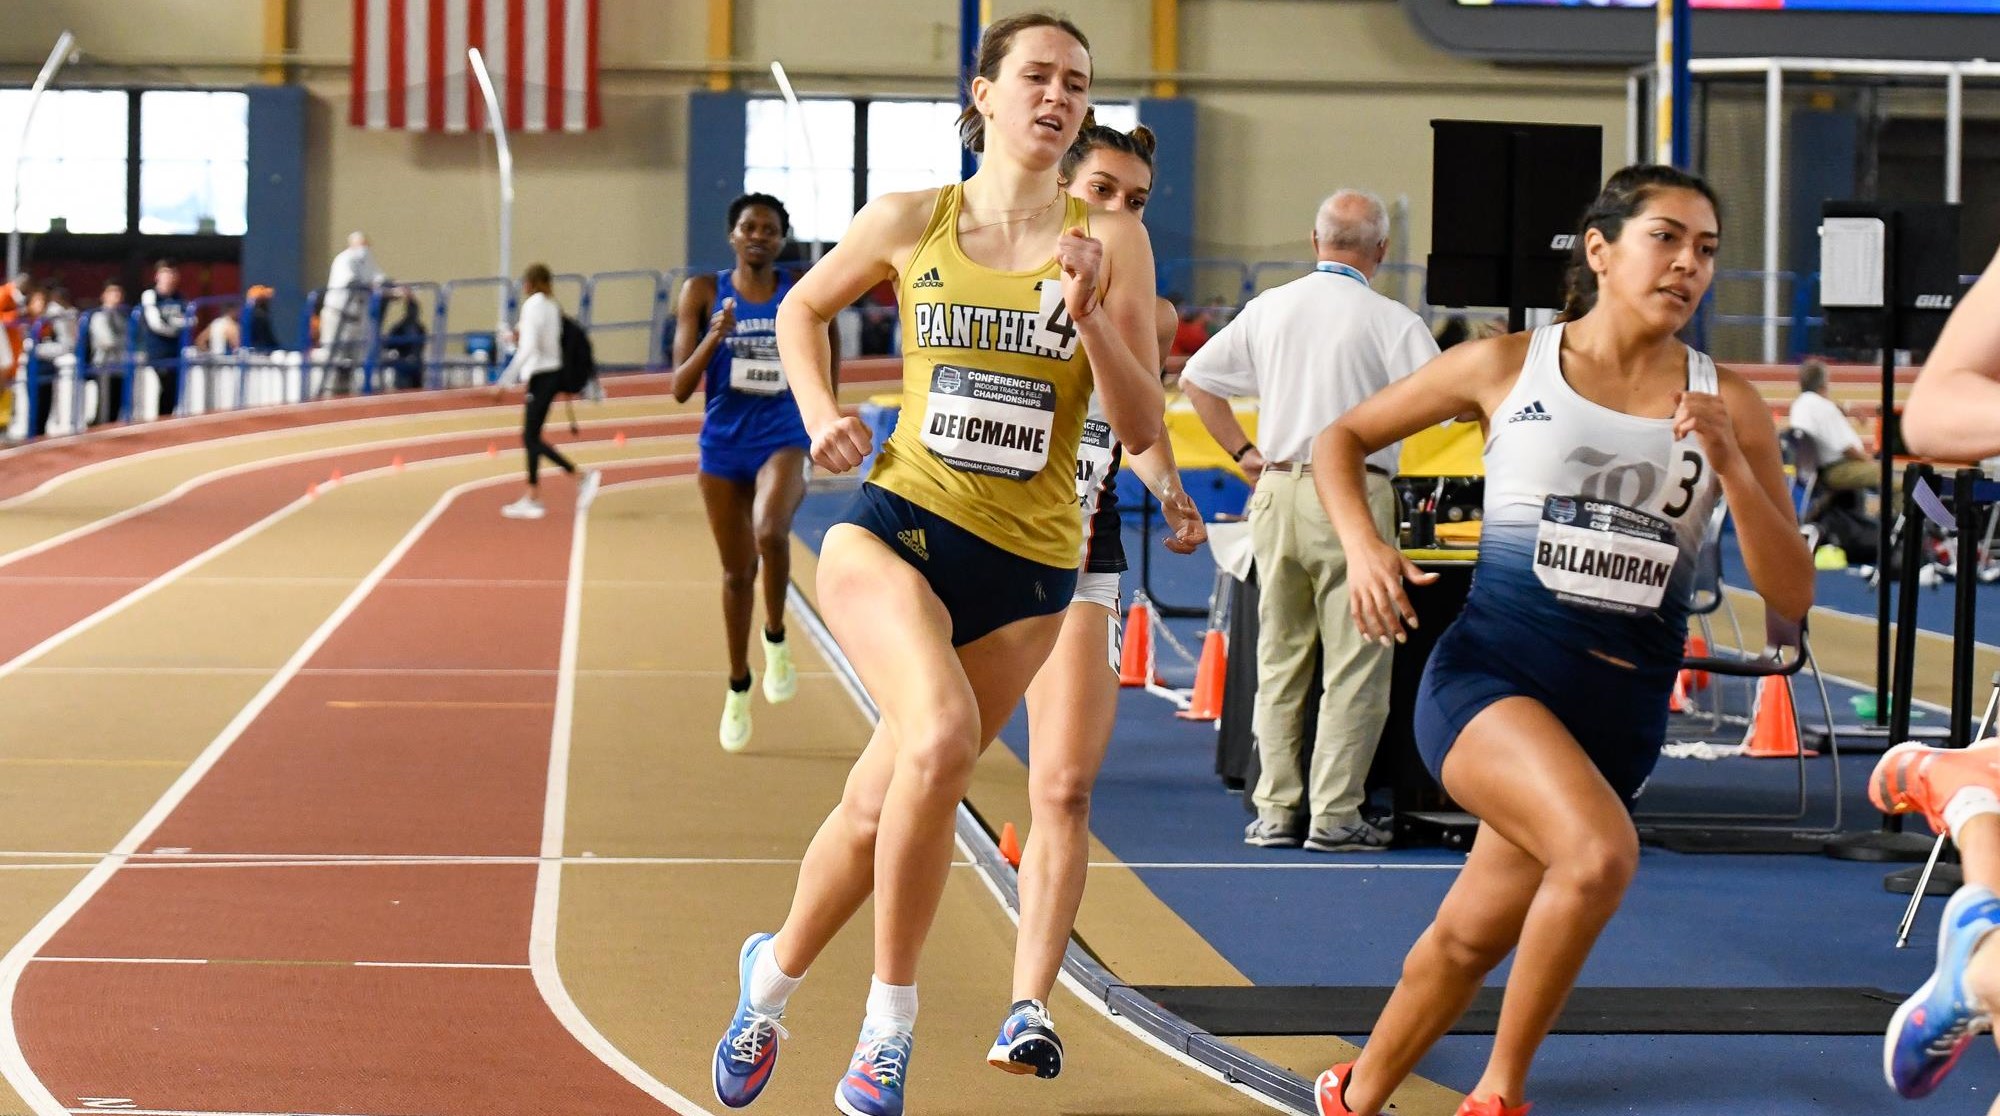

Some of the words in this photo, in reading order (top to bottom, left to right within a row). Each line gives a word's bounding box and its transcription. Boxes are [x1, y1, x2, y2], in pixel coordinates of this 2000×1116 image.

[912, 279, 945, 289] adidas
[915, 303, 1073, 362] PANTHE
[1046, 297, 1077, 349] 4
[967, 371, 1033, 389] CONFERENCE
[1032, 380, 1052, 394] USA
[974, 382, 999, 392] INDOOR
[999, 385, 1019, 396] TRACK
[1020, 389, 1026, 397] &
[1025, 390, 1044, 399] FIELD
[973, 389, 1042, 408] CHAMPIONSHIPS
[930, 412, 1046, 454] DEICMANE
[1096, 424, 1108, 433] USA
[983, 464, 1021, 477] CROSSPLEX
[1662, 450, 1704, 519] 3
[1583, 501, 1651, 526] CONFERENCE
[897, 531, 930, 561] adidas
[1536, 540, 1671, 588] BALANDRAN
